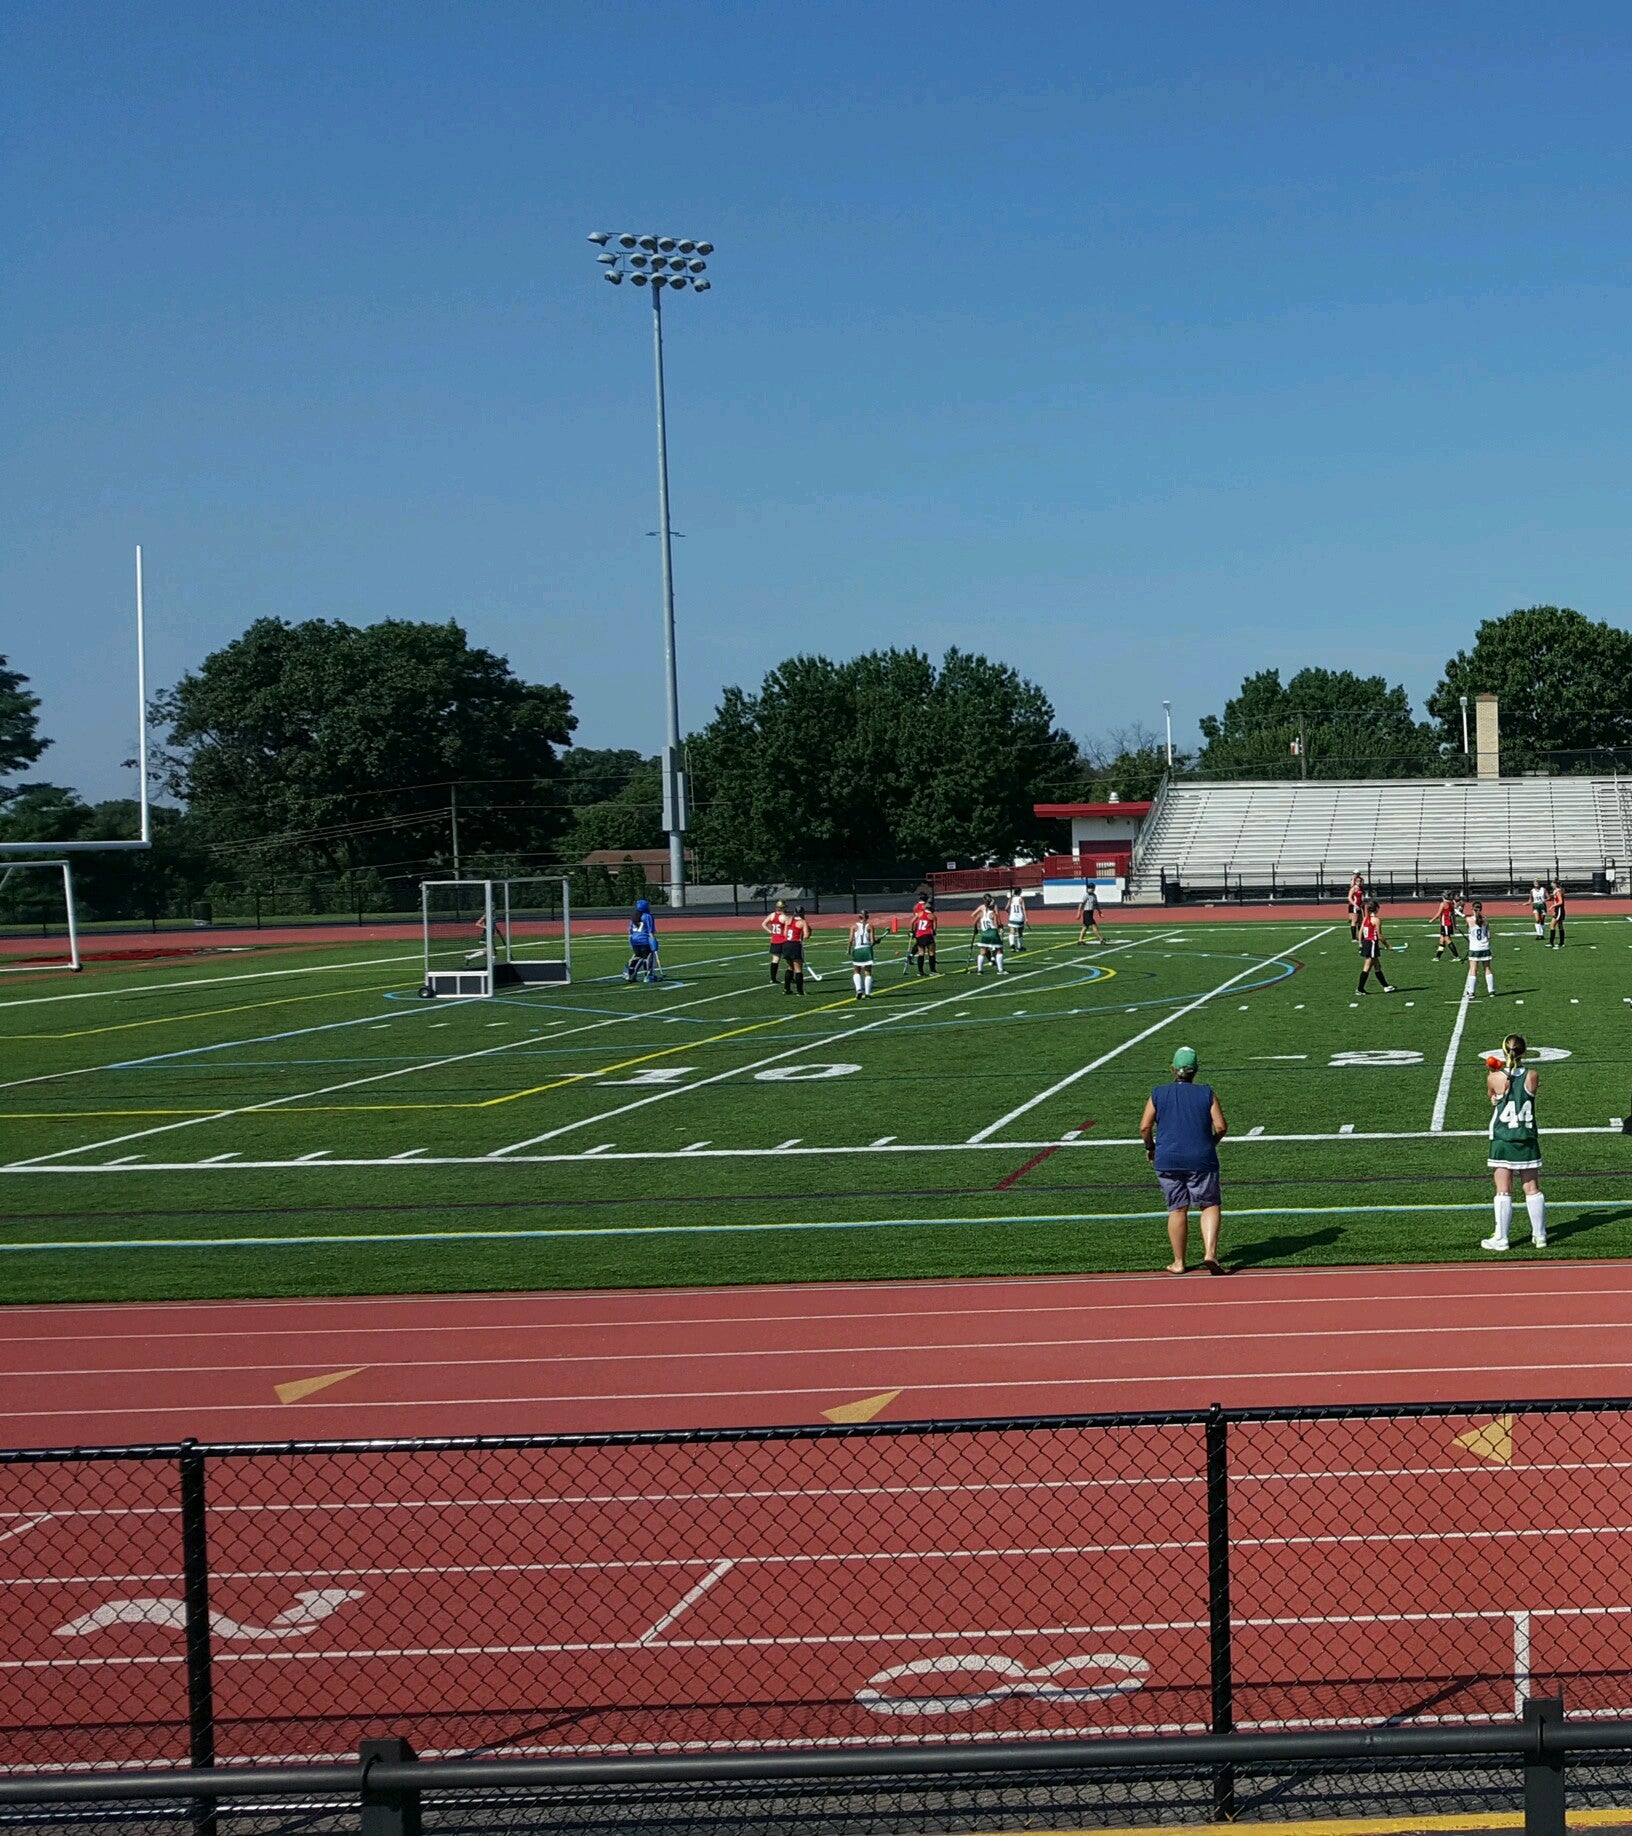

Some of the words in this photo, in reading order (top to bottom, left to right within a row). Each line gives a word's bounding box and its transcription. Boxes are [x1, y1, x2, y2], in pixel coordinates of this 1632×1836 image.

[771, 924, 781, 934] 26
[786, 929, 794, 941] 9
[1500, 1100, 1533, 1129] 44
